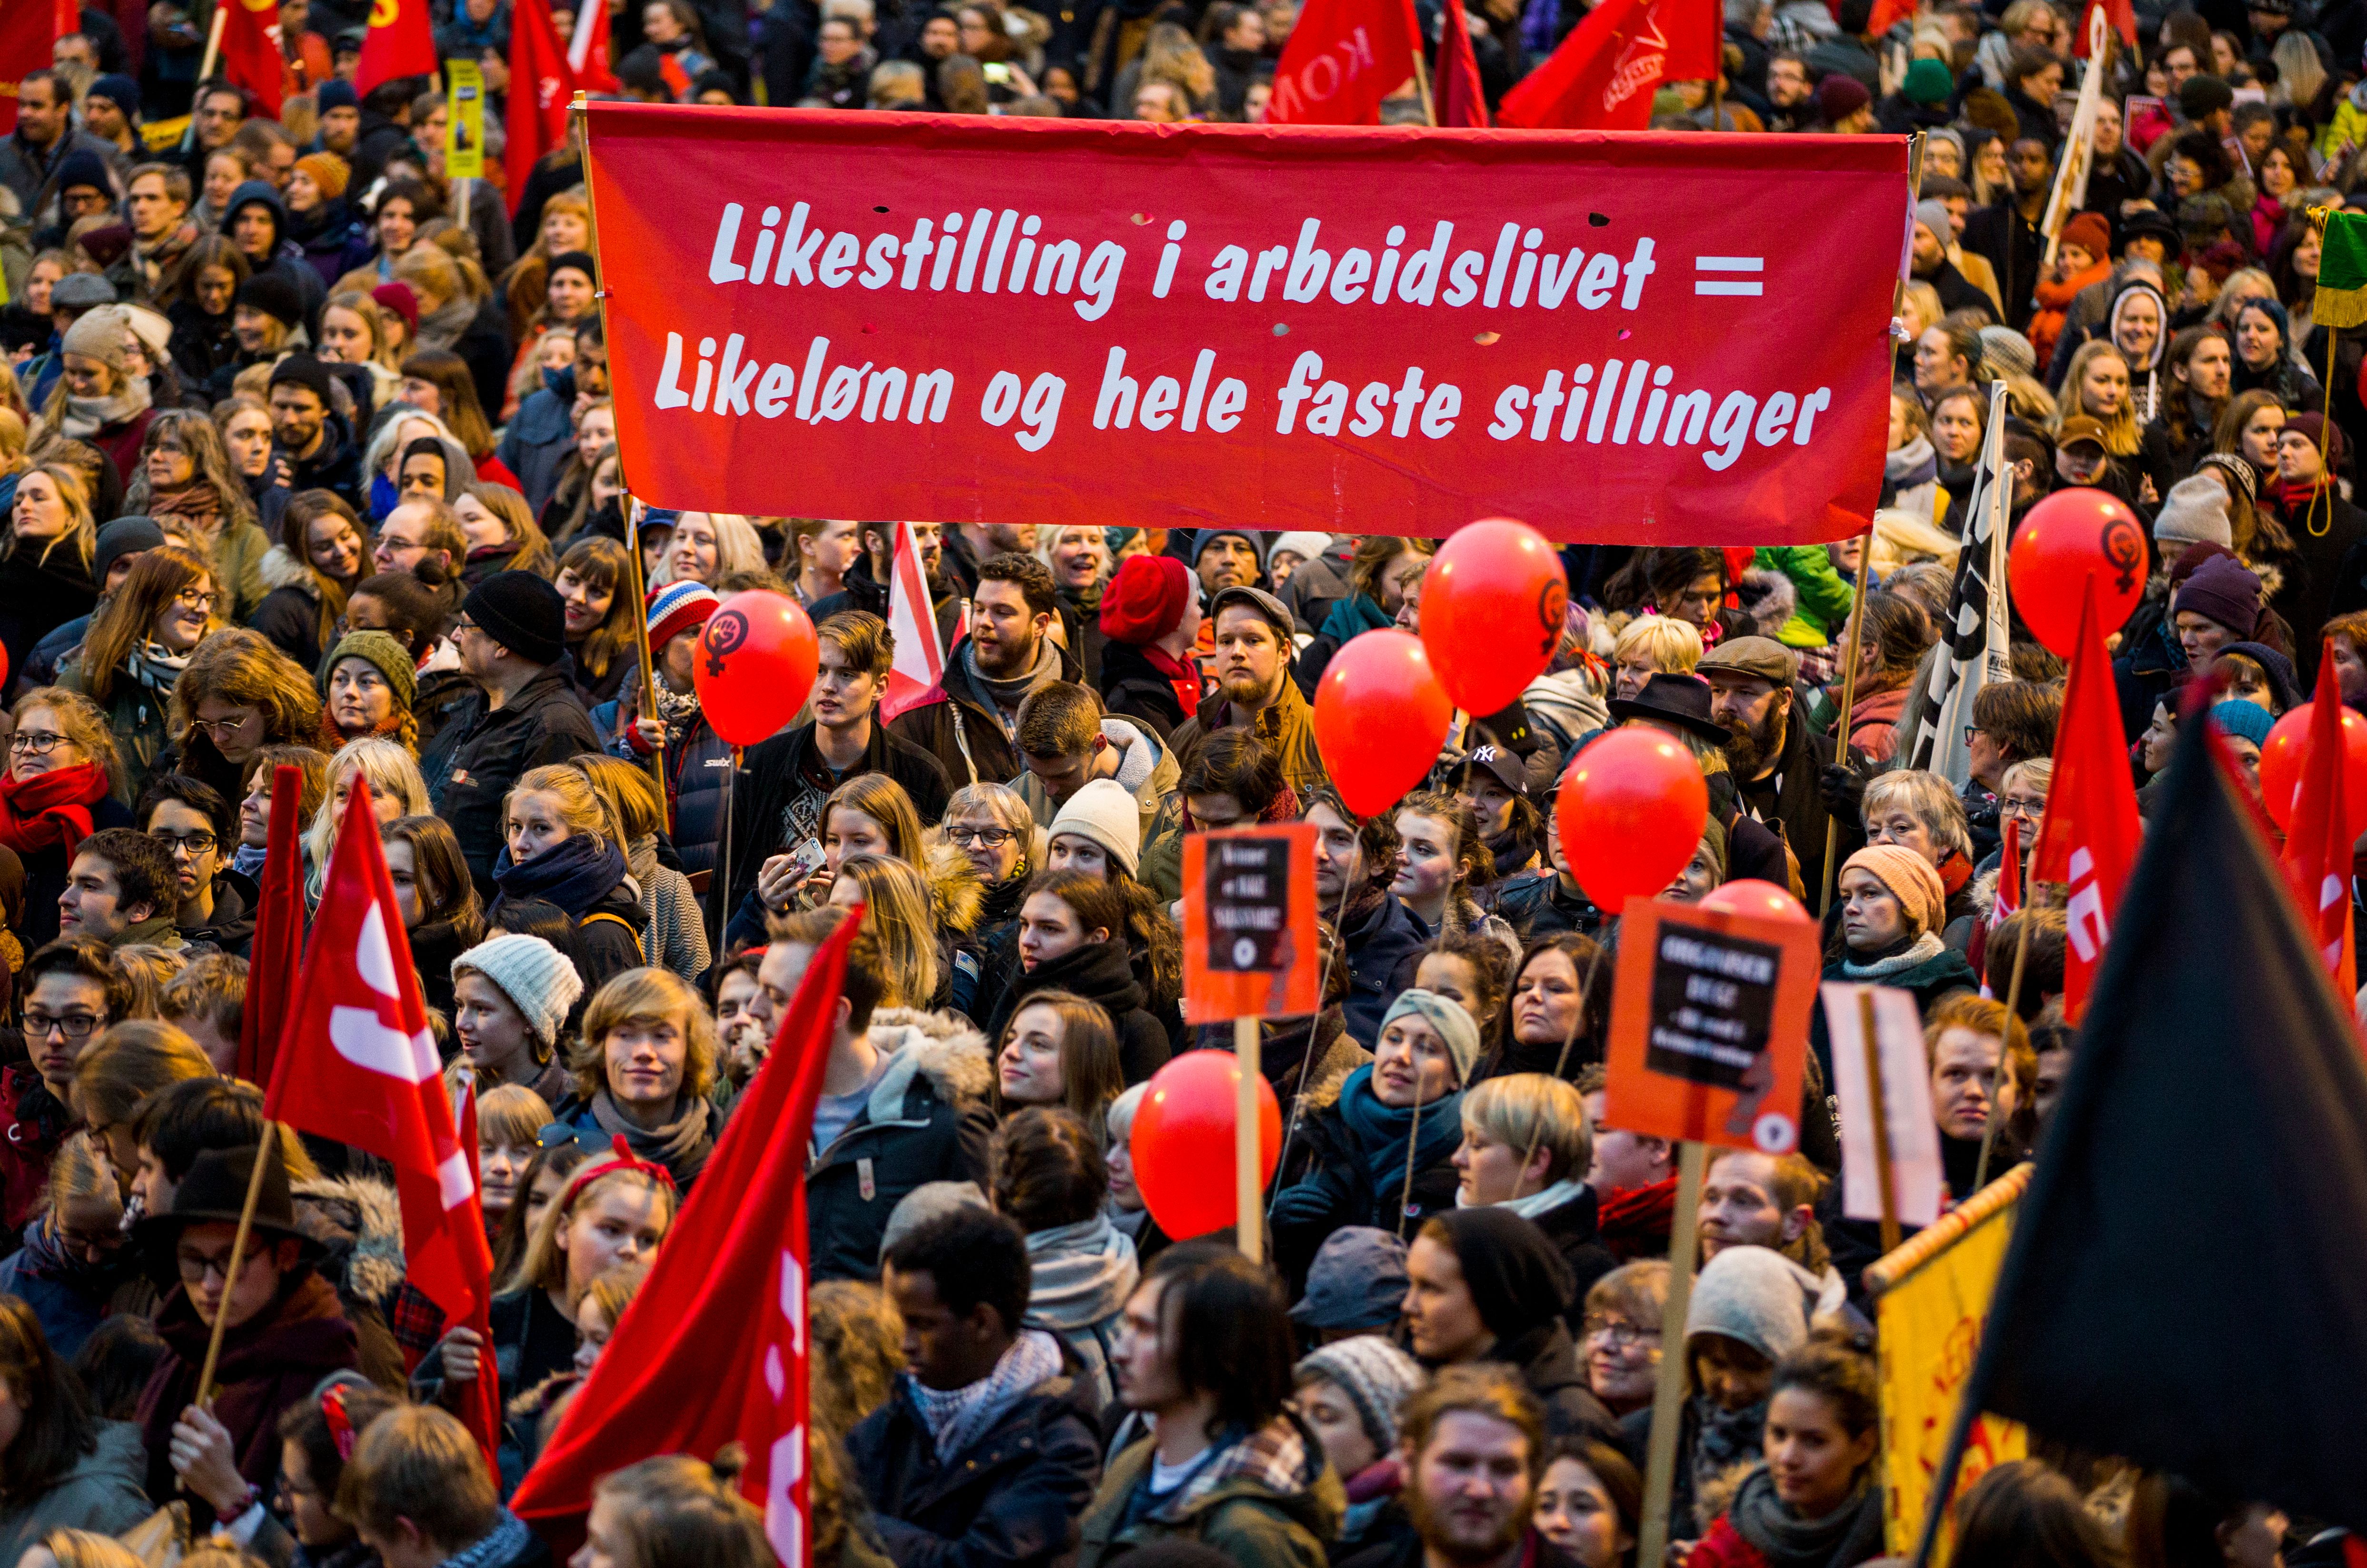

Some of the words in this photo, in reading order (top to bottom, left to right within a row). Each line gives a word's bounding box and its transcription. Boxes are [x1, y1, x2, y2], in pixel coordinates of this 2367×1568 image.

[708, 201, 1127, 322] Likestilling
[1152, 219, 1187, 298] i
[1205, 217, 1655, 310] arbeidslivet
[1695, 256, 1763, 296] =
[654, 332, 954, 425] Likelønn
[980, 370, 1067, 452] og
[1093, 346, 1248, 433] hele
[1276, 350, 1462, 439] faste
[1487, 359, 1831, 471] stillinger
[1473, 746, 1497, 762] NY
